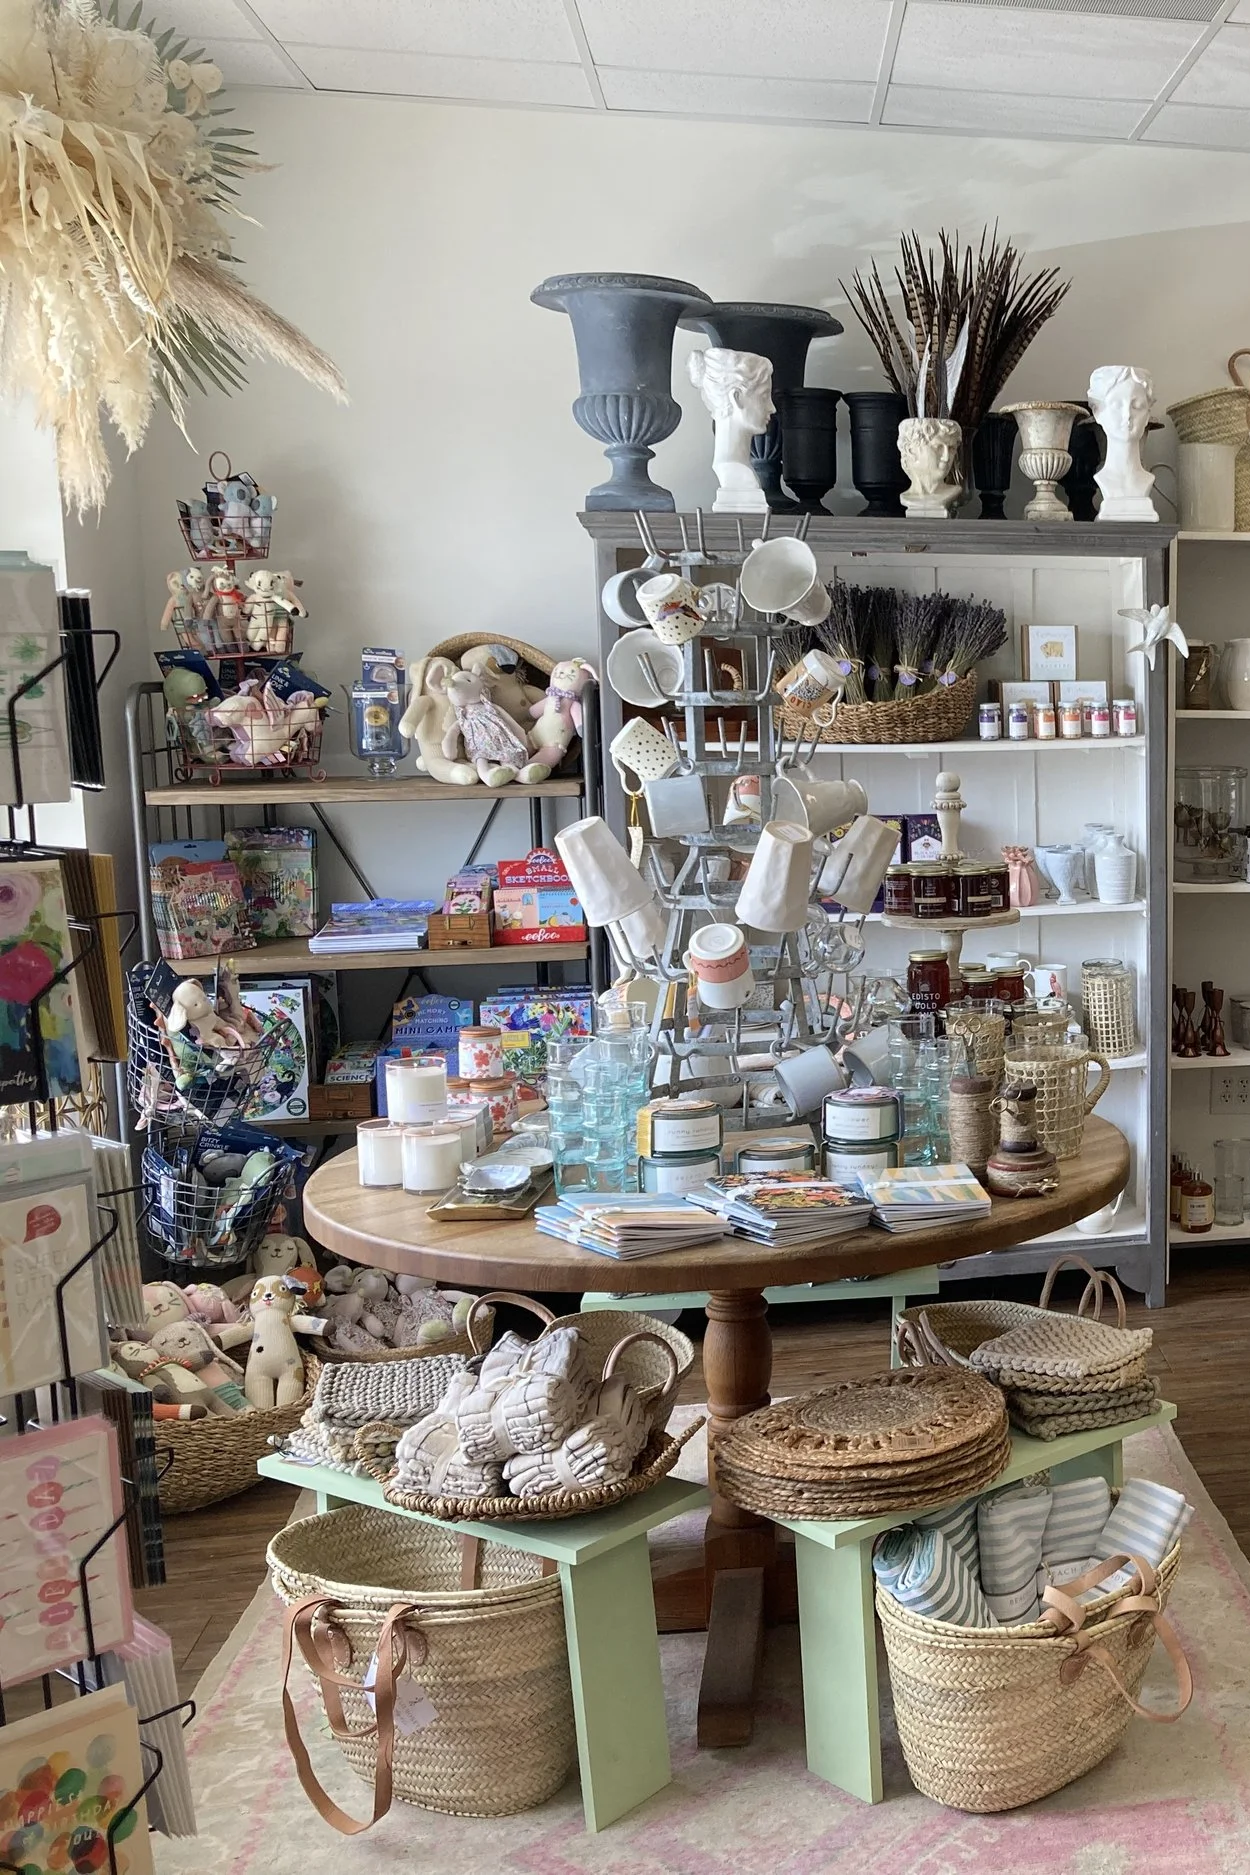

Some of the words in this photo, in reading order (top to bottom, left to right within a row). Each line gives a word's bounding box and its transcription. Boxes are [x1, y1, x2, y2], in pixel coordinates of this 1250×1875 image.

[525, 865, 559, 874] SMALL
[505, 874, 571, 884] SKETCHBOO
[911, 992, 941, 1000] EDISTO
[915, 1002, 937, 1010] GOLD
[394, 1026, 422, 1035] MINI
[0, 1070, 37, 1092] pathy
[199, 1142, 230, 1150] CRINKLE
